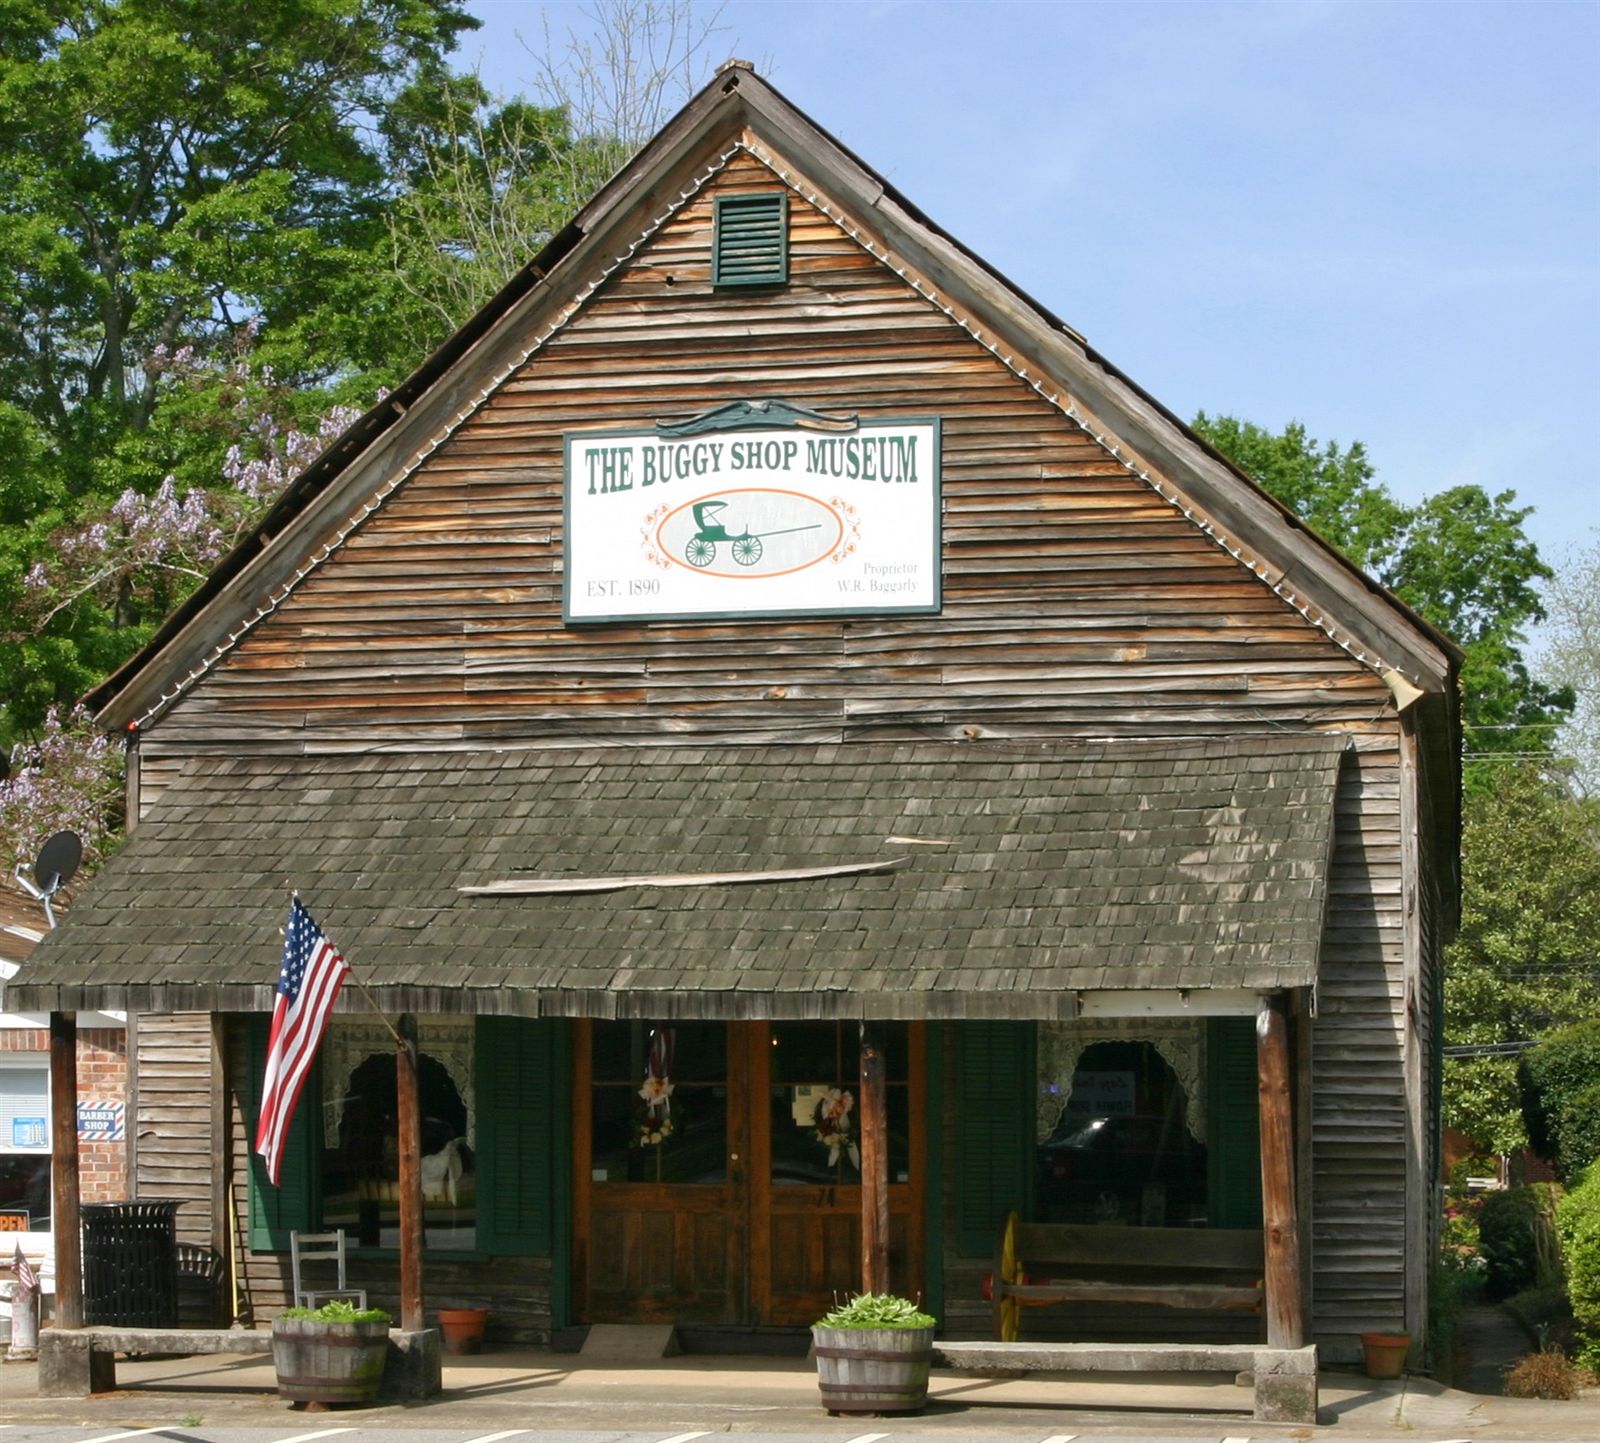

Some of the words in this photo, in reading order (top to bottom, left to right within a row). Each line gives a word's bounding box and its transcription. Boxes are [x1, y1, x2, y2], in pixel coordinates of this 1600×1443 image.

[585, 447, 633, 494] THE
[642, 443, 724, 487] BUGGY
[731, 440, 798, 471] SHOP
[806, 435, 918, 483] MUSEUM
[863, 562, 918, 577] Proprietor
[587, 580, 621, 597] EST.
[628, 578, 660, 596] 1890
[838, 579, 865, 593] W.R.
[870, 578, 918, 596] Baggarly
[79, 1111, 114, 1121] BARBER
[84, 1121, 109, 1130] SHOP
[0, 1216, 27, 1231] PEN
